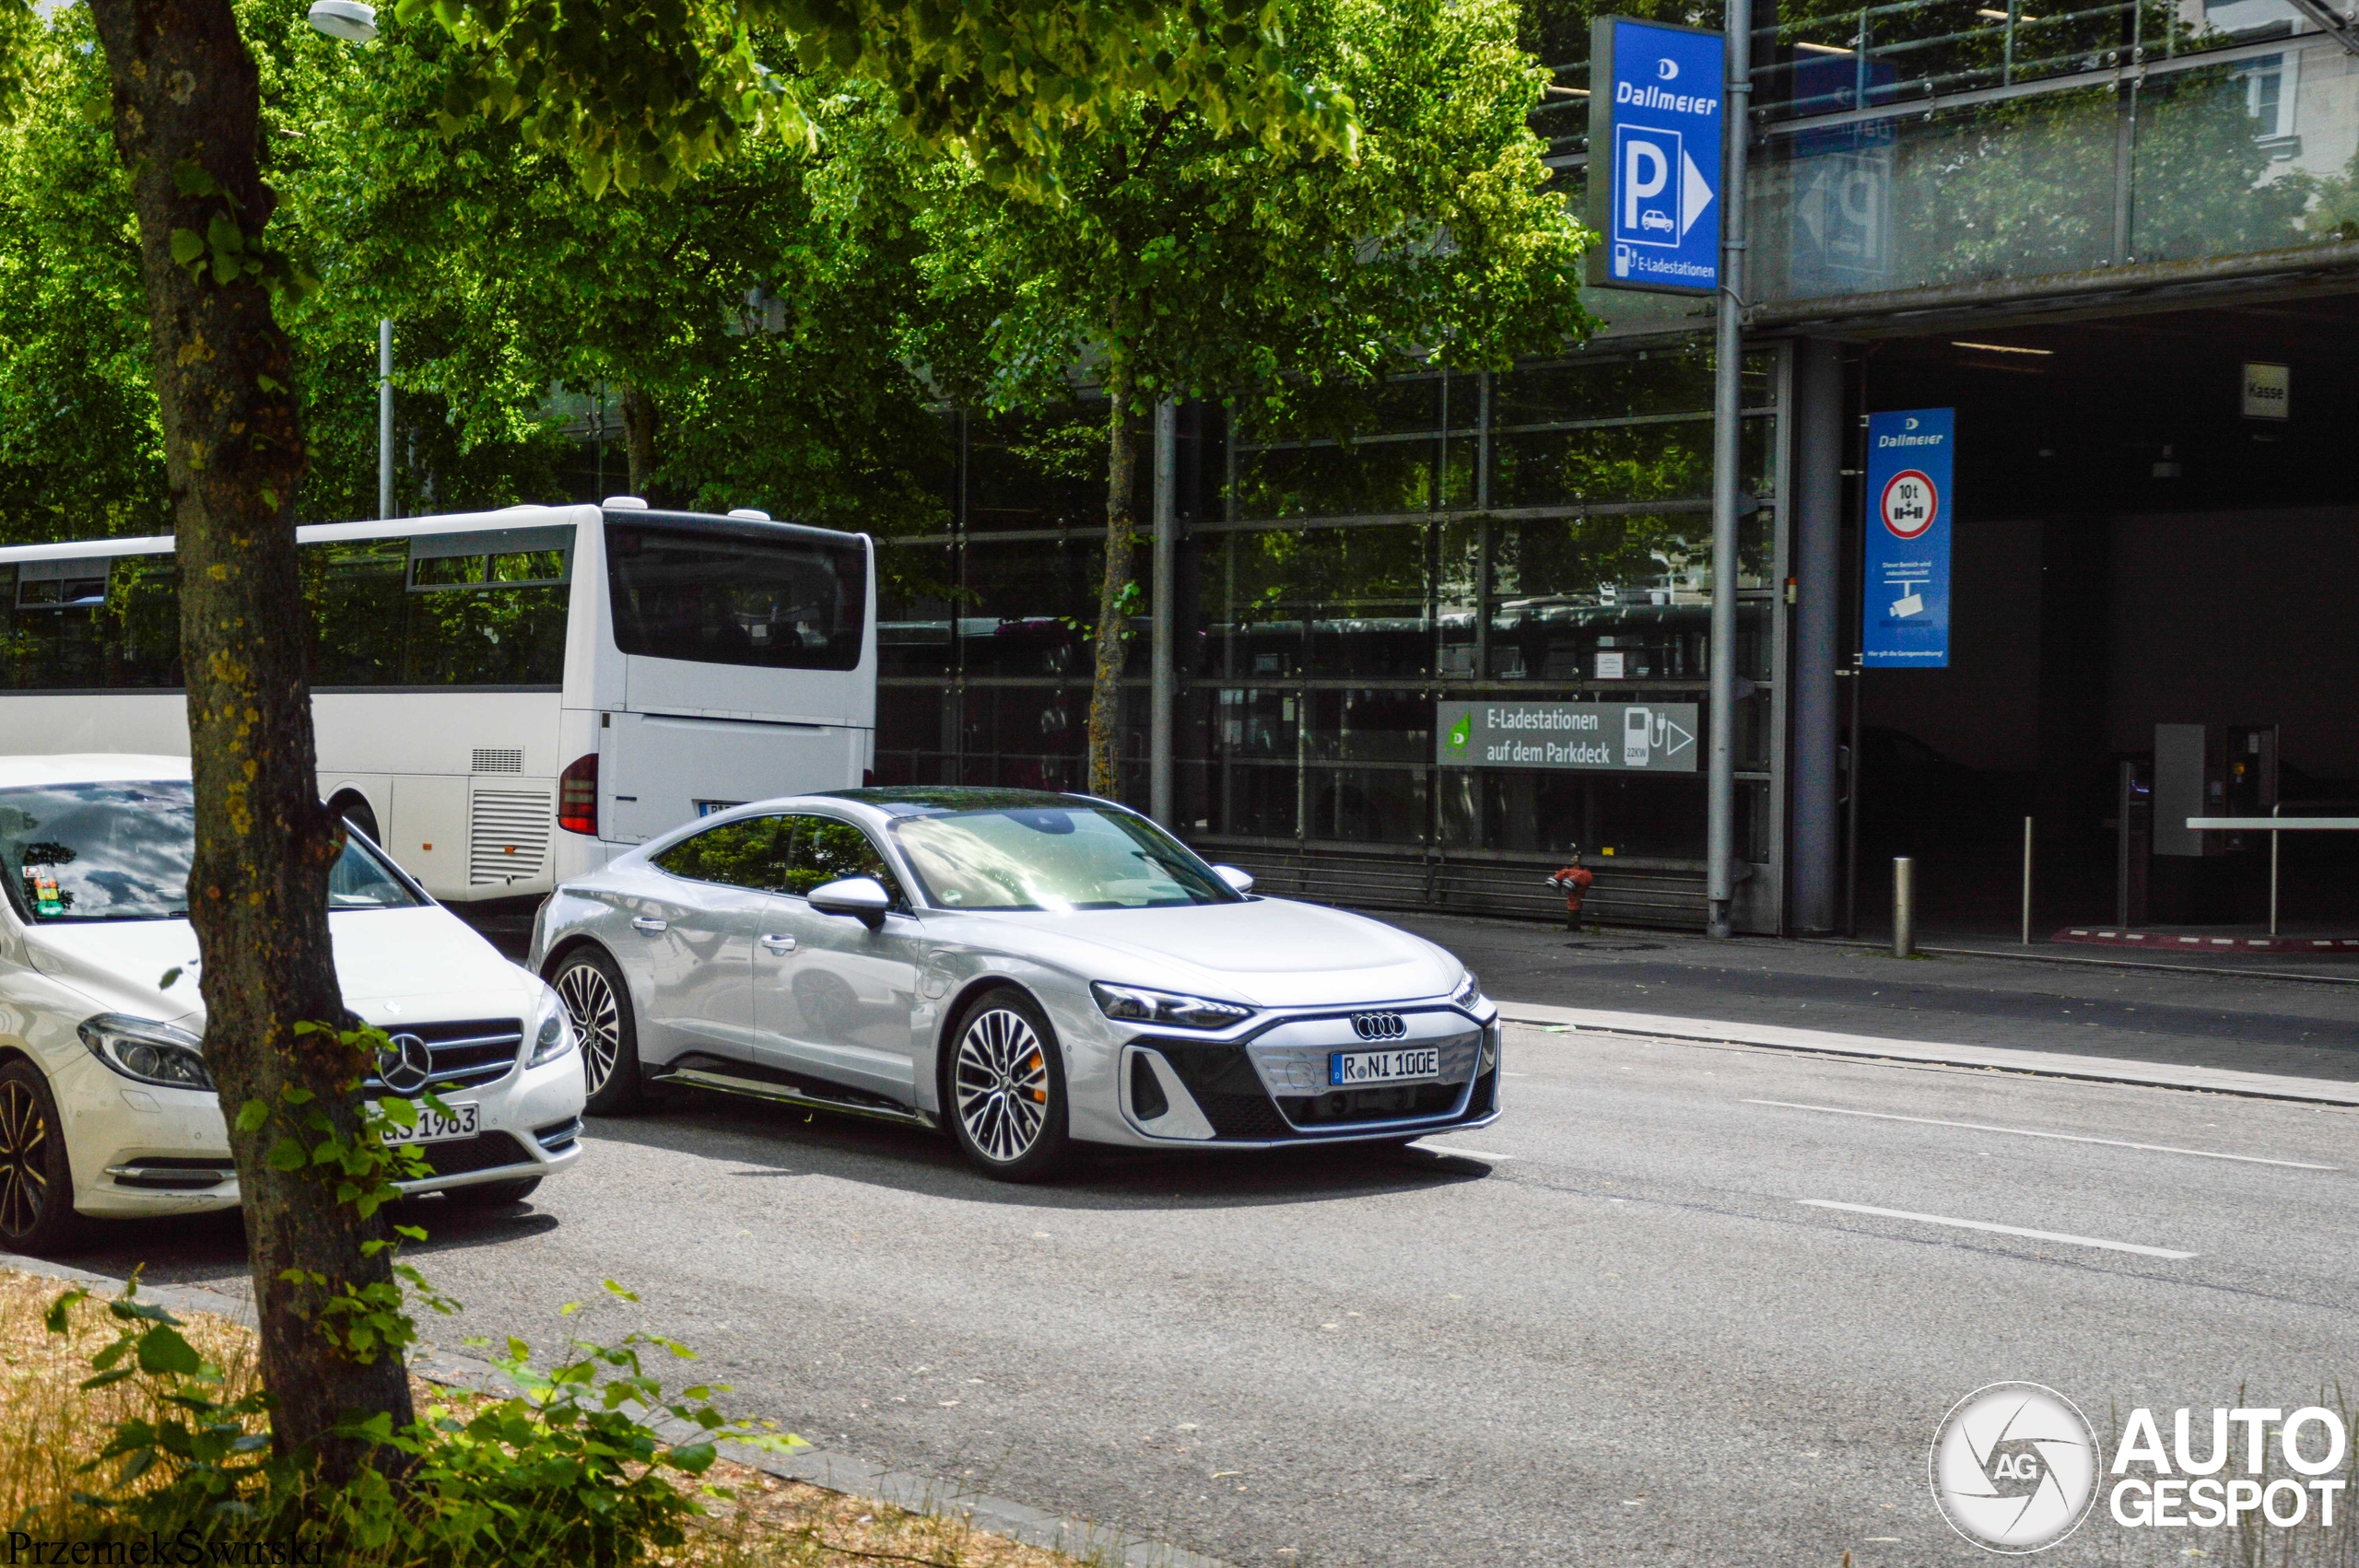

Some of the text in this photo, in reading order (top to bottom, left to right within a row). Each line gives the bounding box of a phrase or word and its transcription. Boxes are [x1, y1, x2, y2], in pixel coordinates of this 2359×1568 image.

[1616, 81, 1717, 115] Dallmeier
[1625, 140, 1668, 228] P
[1638, 257, 1714, 277] E-Ladestationen
[2248, 382, 2283, 400] Kasse
[1879, 434, 1943, 448] Dallmeier
[1899, 485, 1919, 499] 10 t
[1487, 708, 1598, 731] E-Ladestationen
[1487, 741, 1510, 761] auf
[1513, 742, 1543, 762] dem
[1546, 743, 1610, 765] Parkdeck
[1626, 748, 1647, 758] 22KW
[1344, 1057, 1356, 1080] R
[1368, 1055, 1390, 1077] NI
[1395, 1051, 1437, 1076] 100E
[418, 1108, 475, 1137] 1963
